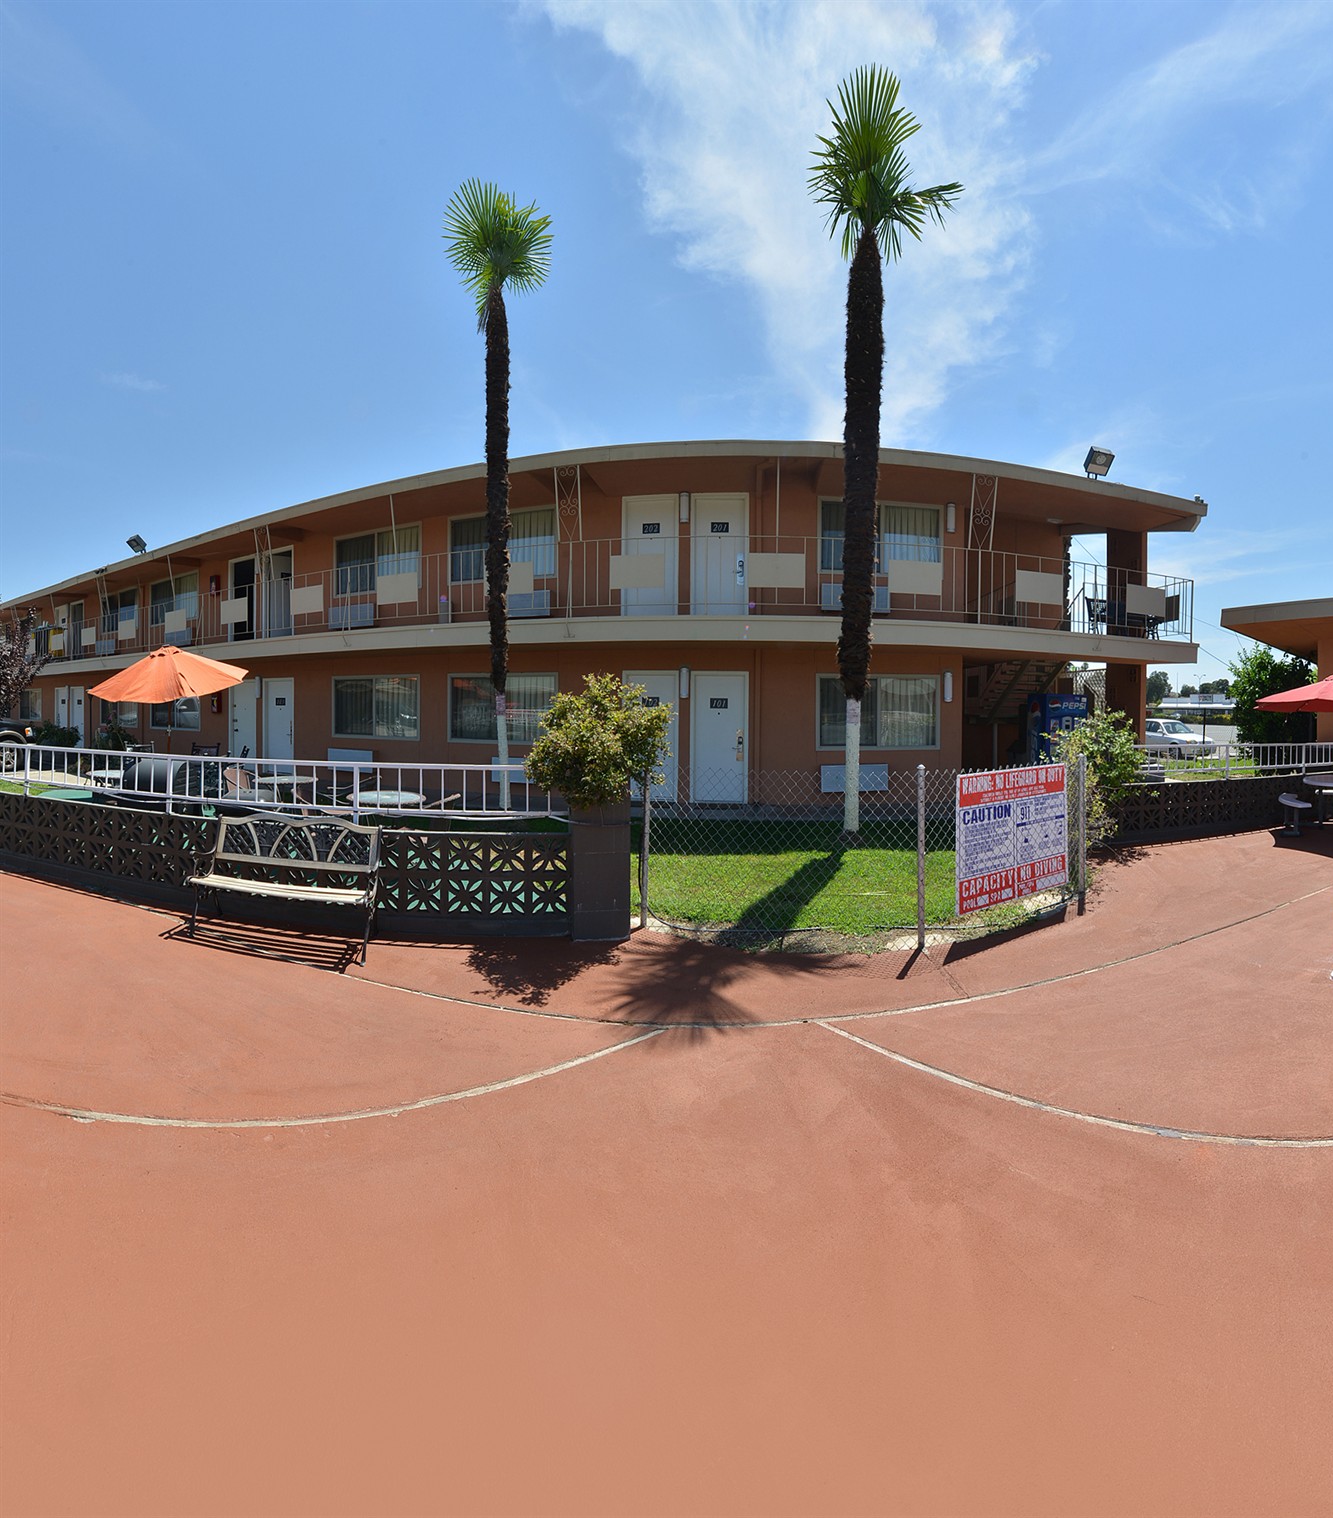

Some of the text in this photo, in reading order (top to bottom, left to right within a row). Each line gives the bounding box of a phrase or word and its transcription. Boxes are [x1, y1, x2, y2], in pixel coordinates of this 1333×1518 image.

[643, 524, 659, 533] 202
[712, 523, 727, 532] 201
[712, 699, 726, 708] 101
[1062, 702, 1087, 710] PEPSI
[962, 775, 994, 795] WARNING:
[995, 773, 1004, 790] NO
[1005, 769, 1037, 789] LIFEGUARD
[1038, 768, 1046, 784] ON
[1047, 767, 1063, 783] DUTY
[963, 803, 1011, 825] CAUTION
[1020, 806, 1030, 821] 911
[1020, 856, 1063, 881] NO DIVING
[962, 869, 1013, 898] CAPACITY
[963, 890, 1002, 911] POOL SPA
